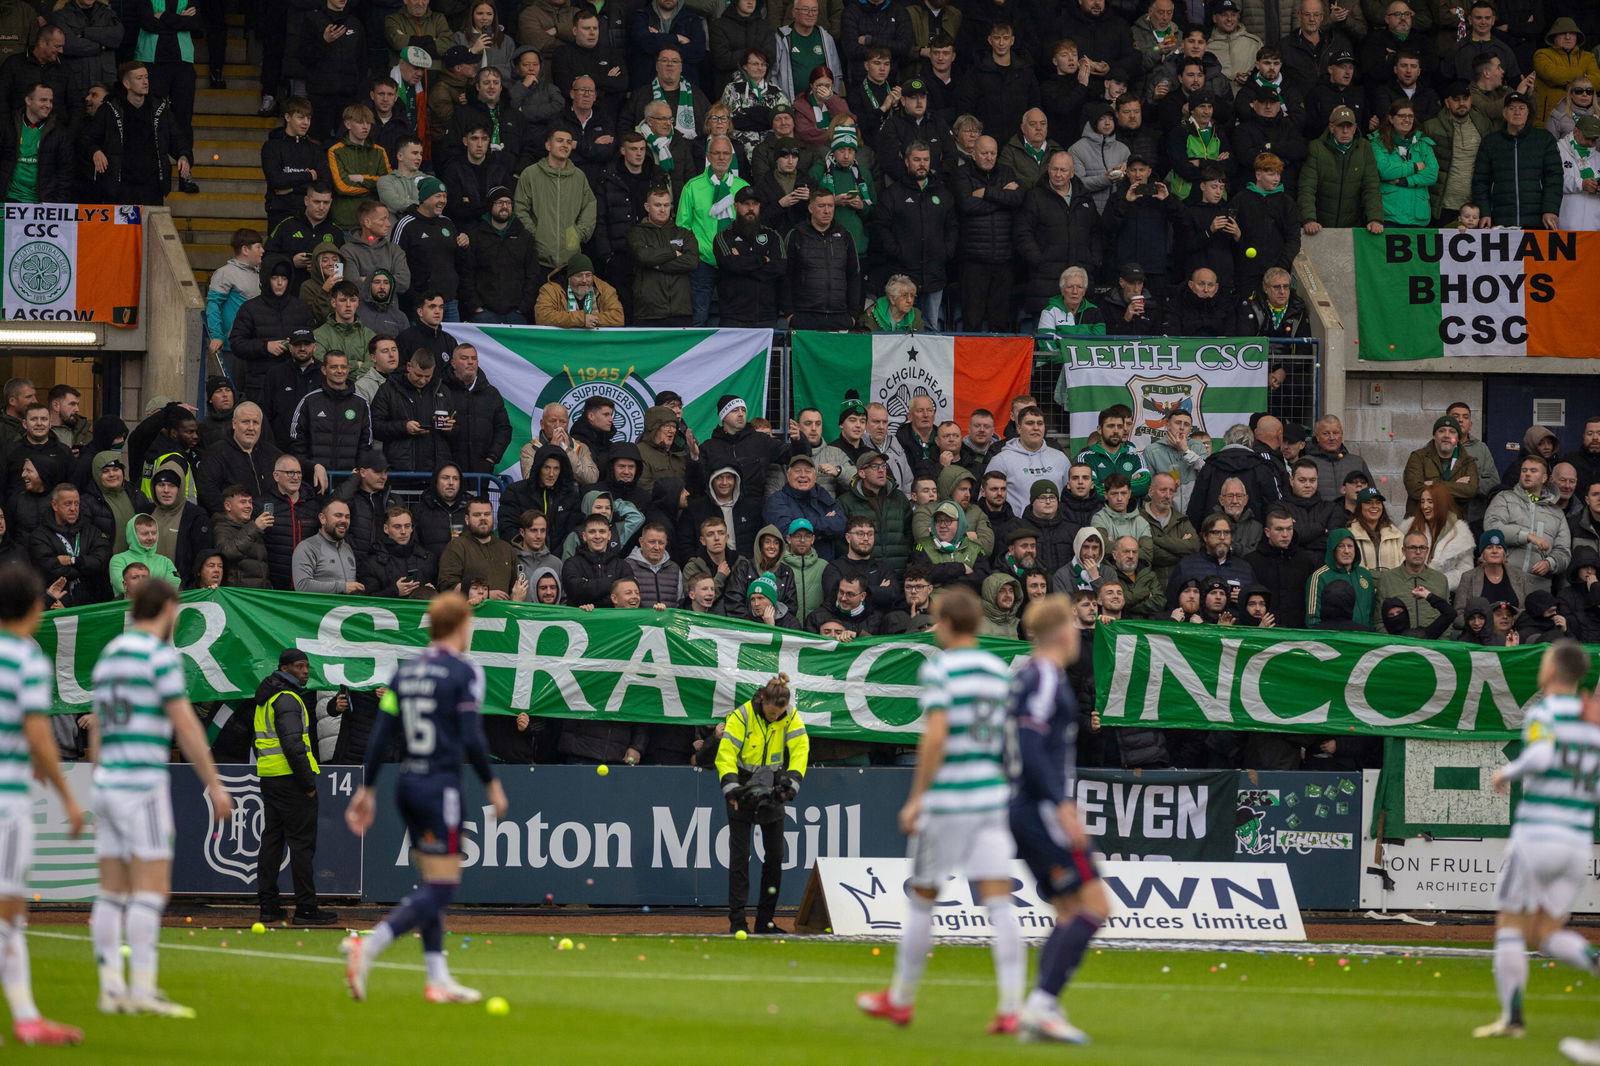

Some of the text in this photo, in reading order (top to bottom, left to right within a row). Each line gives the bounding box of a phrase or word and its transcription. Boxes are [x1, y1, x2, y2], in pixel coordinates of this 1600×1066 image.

[0, 206, 110, 222] EY REILLY'S
[24, 223, 59, 238] CSC
[1385, 232, 1577, 263] BUCHAN
[1409, 273, 1555, 304] BHOYS
[1439, 315, 1529, 345] CSC
[1066, 341, 1263, 370] LEITH CSC
[577, 367, 620, 381] 1945
[879, 366, 948, 408] OCHGILPHEAD
[572, 385, 635, 411] SUPPORTERS
[1151, 385, 1183, 394] LEITH
[31, 601, 241, 704] UR
[1103, 634, 1600, 730] INCOM
[401, 697, 437, 756] 15
[328, 771, 353, 797] 14
[1064, 778, 1209, 840] EVEN
[395, 804, 633, 869] shton
[1430, 858, 1504, 874] FRULL
[1193, 912, 1288, 930] limited
